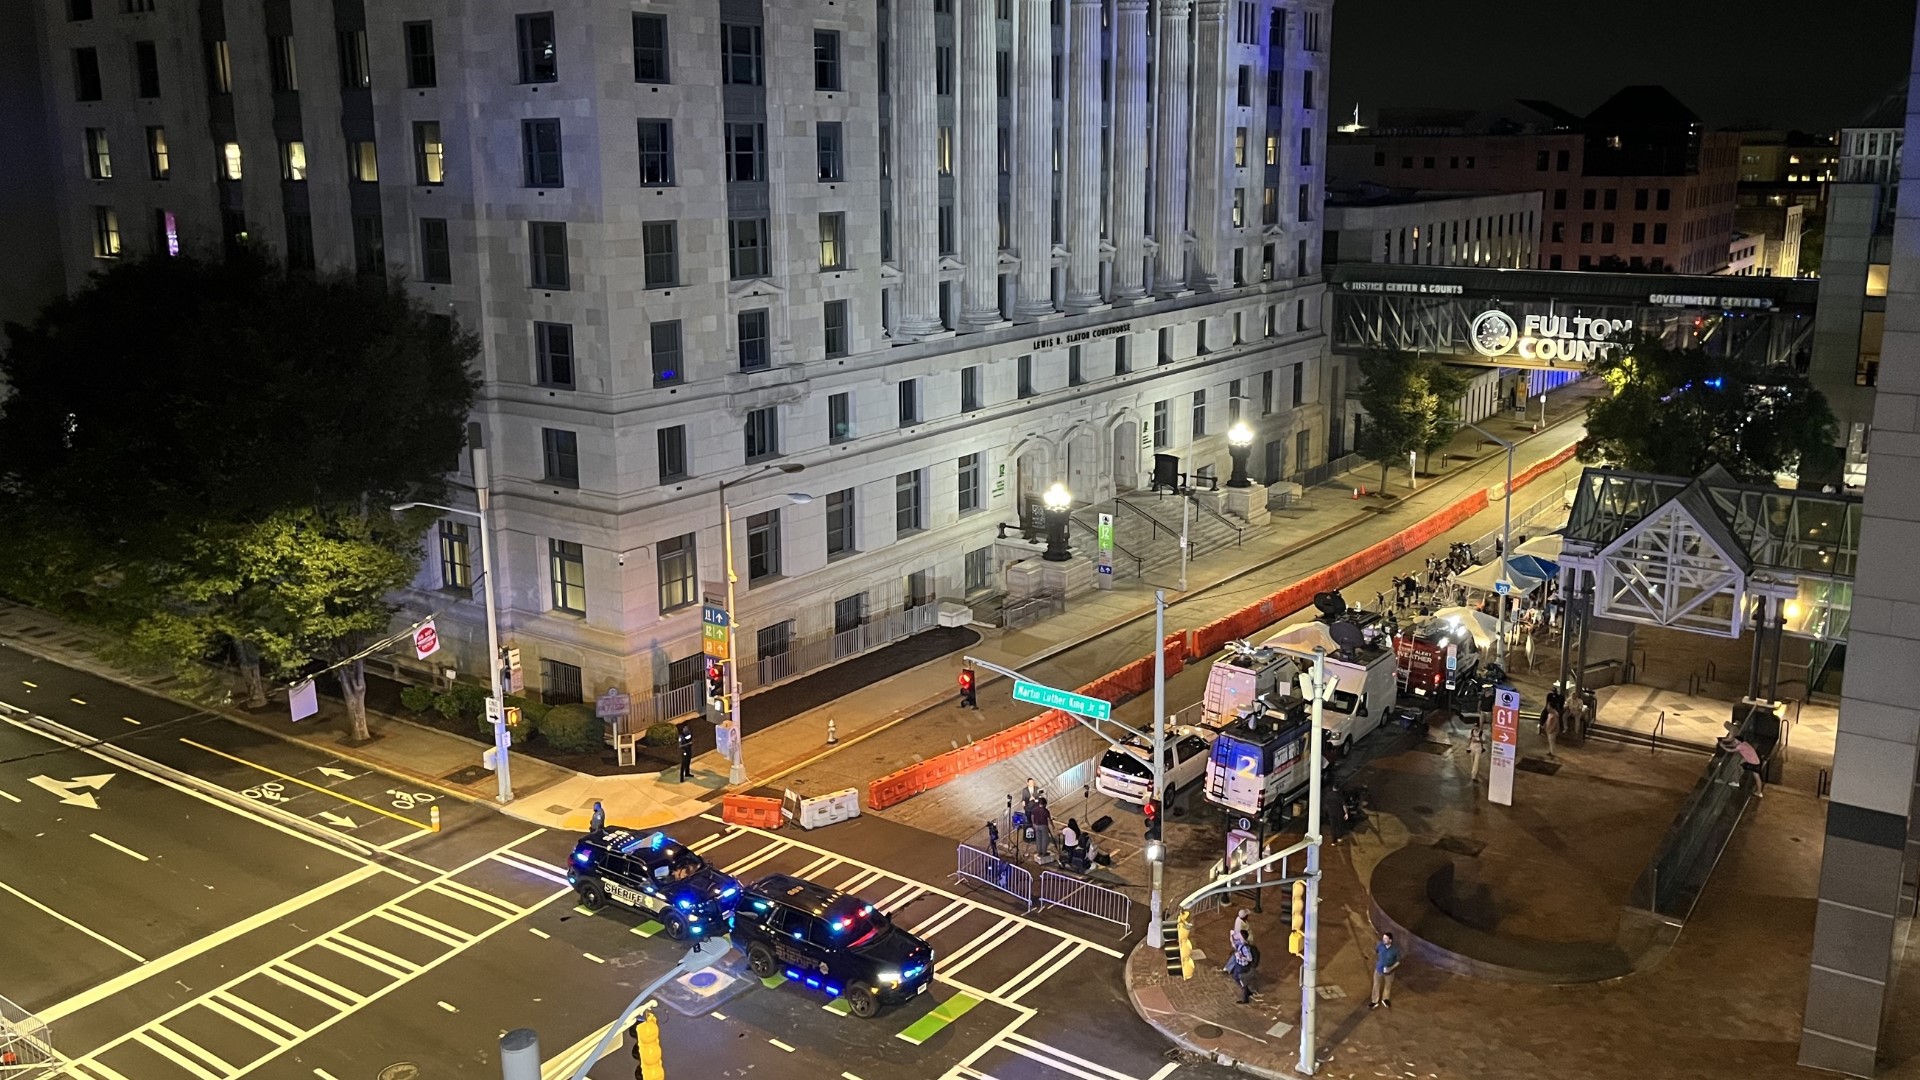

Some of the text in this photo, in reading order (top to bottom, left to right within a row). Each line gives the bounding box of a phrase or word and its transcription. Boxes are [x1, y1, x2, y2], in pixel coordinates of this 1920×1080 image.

[1352, 282, 1463, 294] JUSTICE CENTER & COURTS
[1649, 294, 1761, 307] GOVERNMENT CENTER
[1524, 314, 1633, 341] FULTON
[1033, 339, 1053, 350] LEWIS
[1092, 323, 1131, 338] COURTHOUSE
[1100, 526, 1110, 540] J2
[1499, 585, 1507, 593] 20
[1397, 651, 1432, 663] WEATHER
[1018, 686, 1040, 698] Martin
[1043, 690, 1066, 705] Luther
[1069, 698, 1084, 713] King
[1087, 703, 1095, 712] Jr
[1497, 709, 1512, 725] G1
[1238, 756, 1256, 779] 2
[604, 882, 643, 903] SHERIFF
